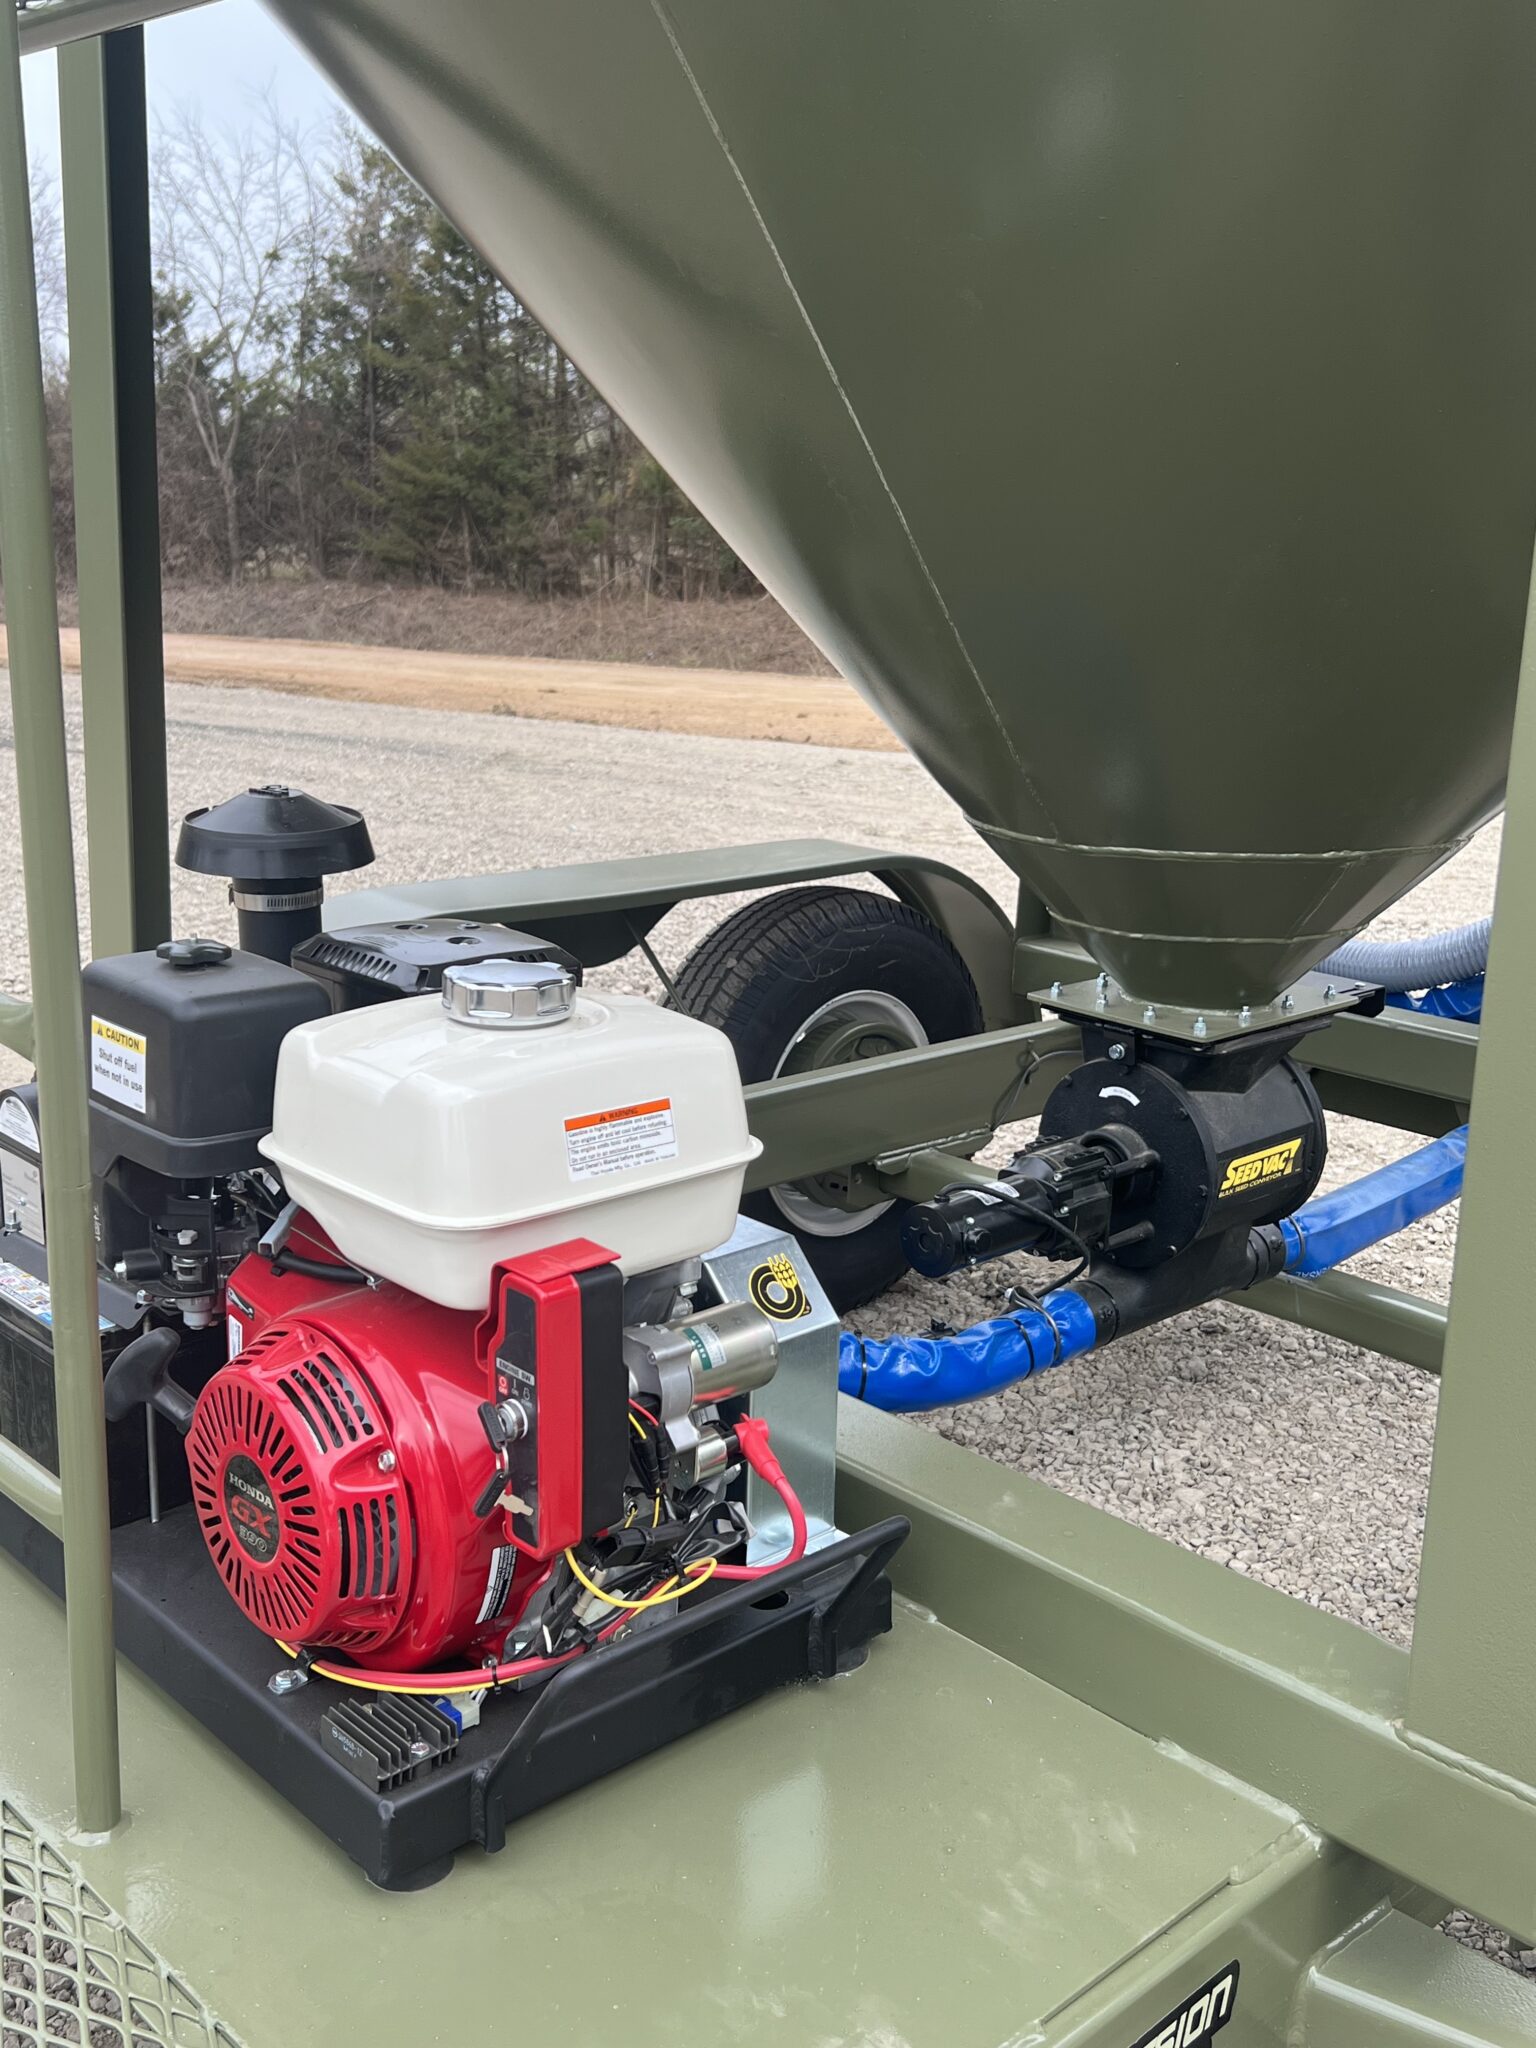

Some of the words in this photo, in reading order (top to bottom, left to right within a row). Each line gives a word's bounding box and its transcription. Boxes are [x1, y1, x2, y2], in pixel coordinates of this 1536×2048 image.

[106, 1028, 140, 1050] CAUTION
[99, 1048, 113, 1063] Shut
[114, 1056, 123, 1068] off
[124, 1059, 137, 1073] fuel
[94, 1064, 110, 1078] when
[111, 1072, 122, 1084] not
[131, 1083, 143, 1093] use
[609, 1107, 638, 1119] WARNING
[1234, 1183, 1249, 1193] SEED
[1249, 1171, 1282, 1188] CONVEYOR
[228, 1472, 275, 1511] HONDA
[231, 1494, 273, 1539] GX
